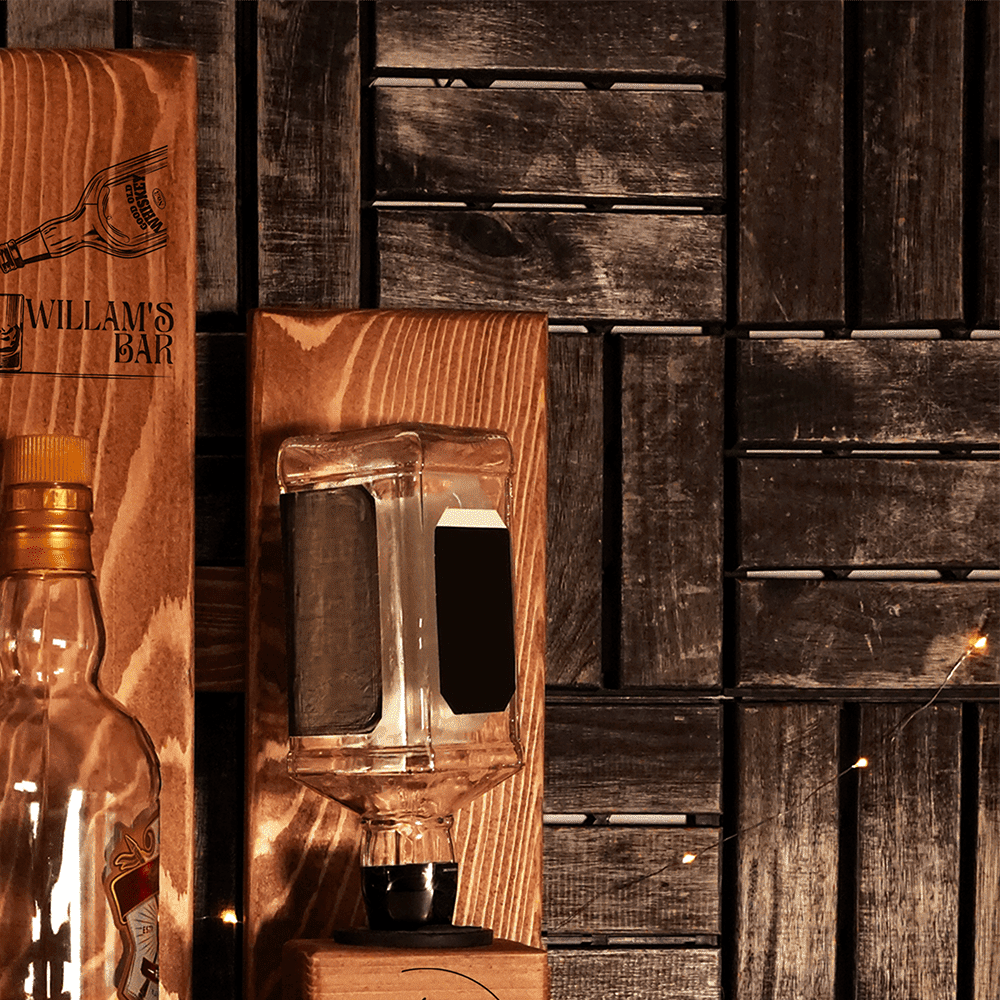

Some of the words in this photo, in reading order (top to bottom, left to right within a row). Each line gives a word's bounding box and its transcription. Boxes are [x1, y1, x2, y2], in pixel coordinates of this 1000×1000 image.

[125, 184, 135, 204] OLD
[132, 174, 163, 234] WHISKEY
[130, 205, 147, 230] GOOD
[26, 298, 174, 333] WILLAM'S
[114, 333, 174, 365] BAR
